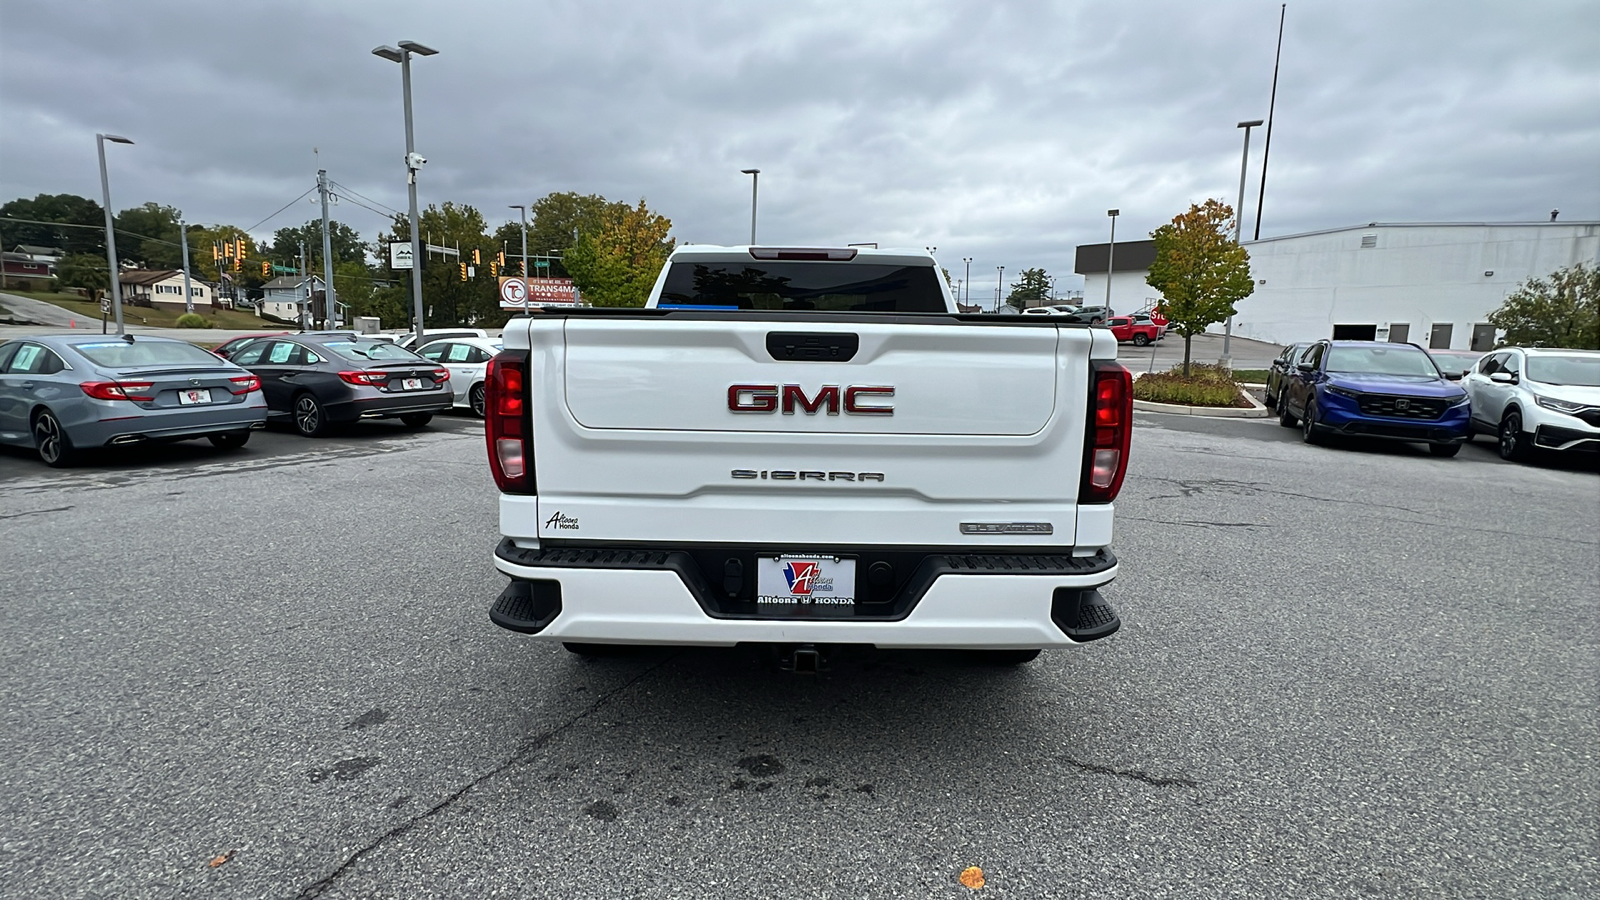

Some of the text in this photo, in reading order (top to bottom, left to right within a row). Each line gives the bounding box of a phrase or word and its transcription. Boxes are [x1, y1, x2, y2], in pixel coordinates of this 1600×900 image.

[727, 383, 896, 417] GMC
[731, 469, 885, 482] SIERRA
[967, 523, 1047, 532] ELEVATION
[757, 596, 798, 604] Altoona
[815, 597, 855, 605] HONDA
